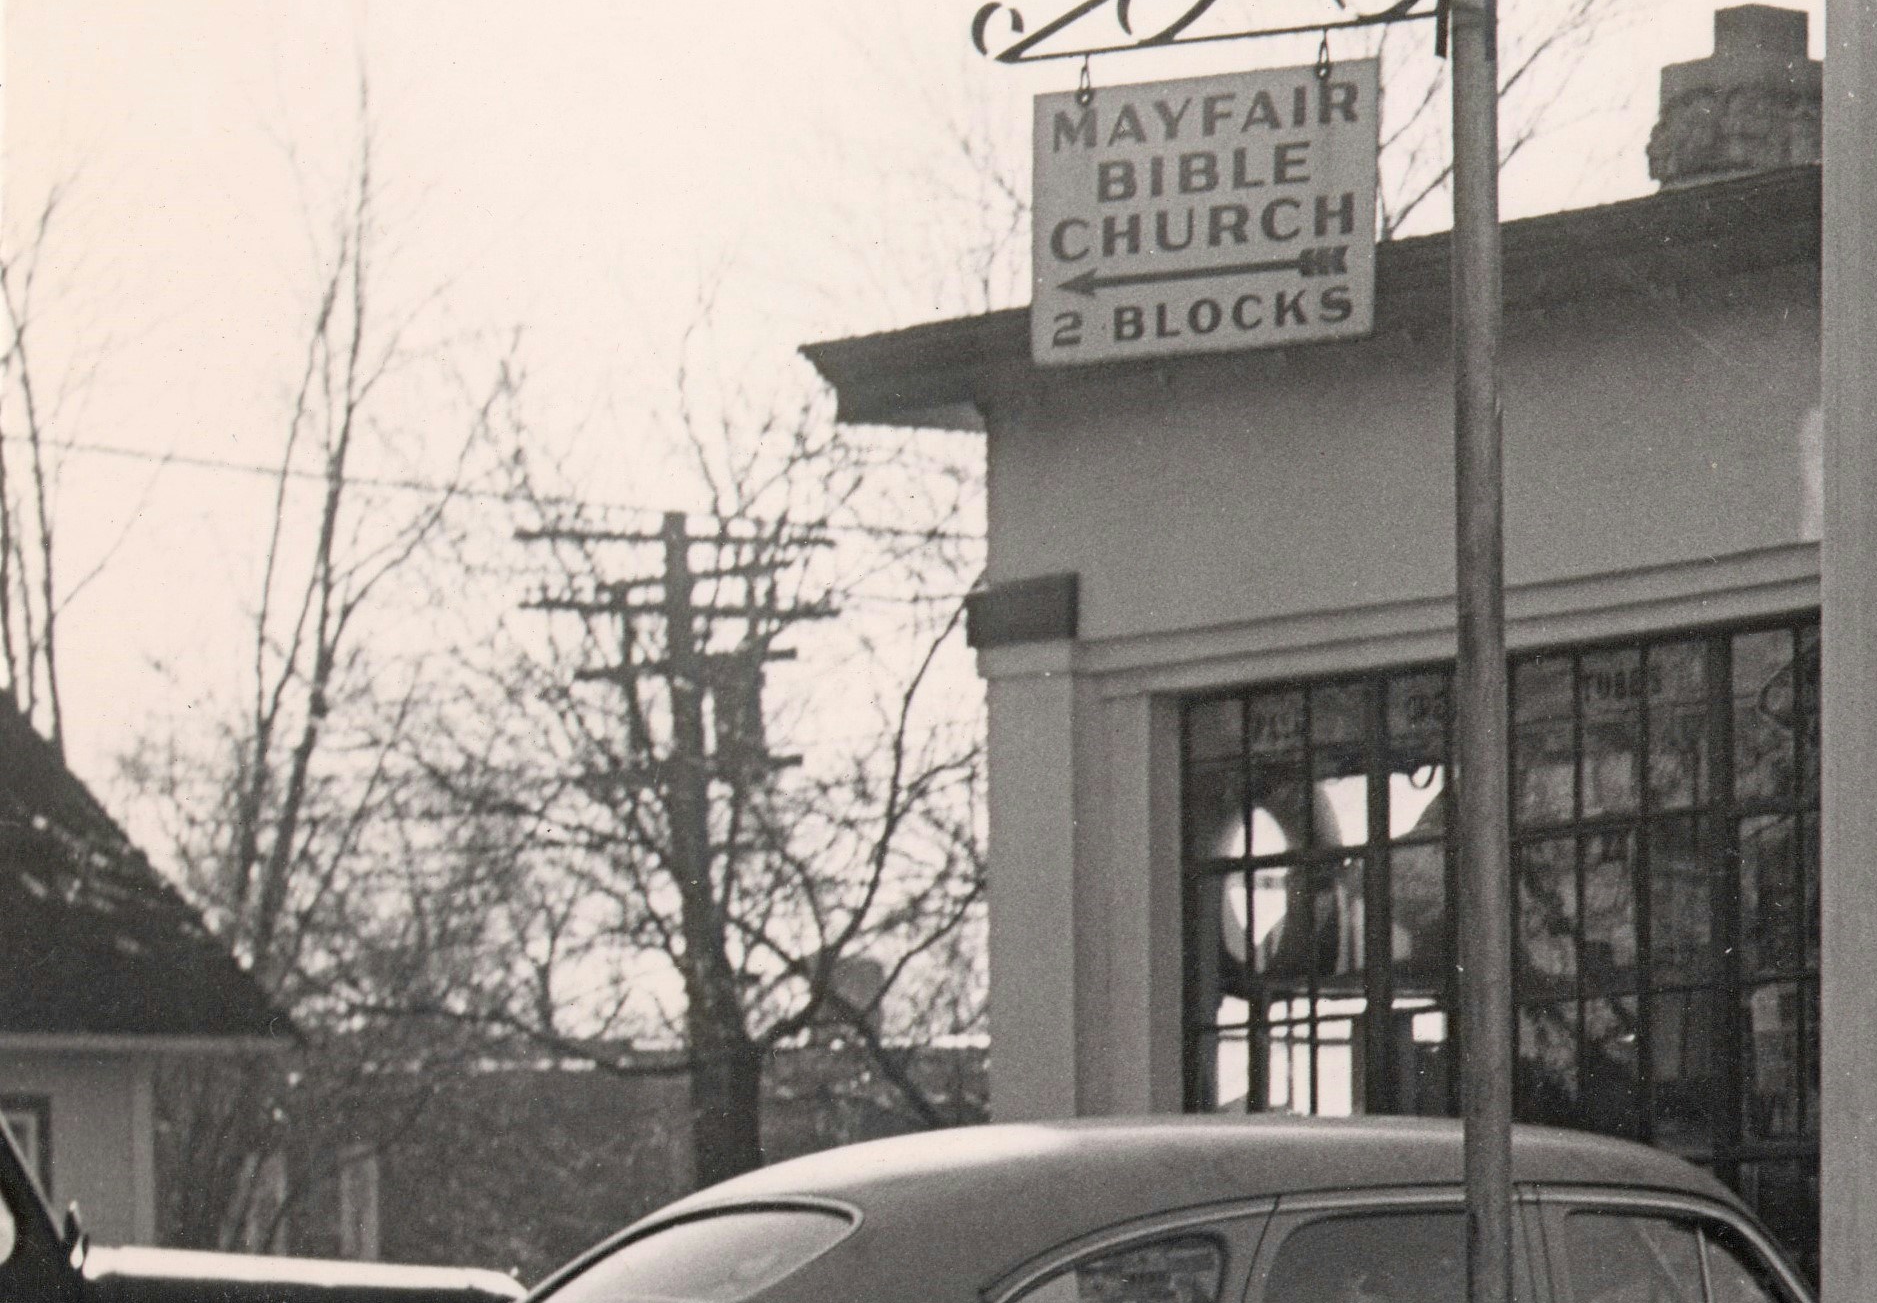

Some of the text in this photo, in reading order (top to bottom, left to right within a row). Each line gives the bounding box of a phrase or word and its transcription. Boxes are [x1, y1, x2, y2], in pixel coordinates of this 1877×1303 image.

[1051, 80, 1360, 154] MAYFAIR
[1098, 140, 1312, 204] BIBLE
[1049, 191, 1355, 262] CHURCH
[1051, 284, 1354, 349] 2 BLOCKS
